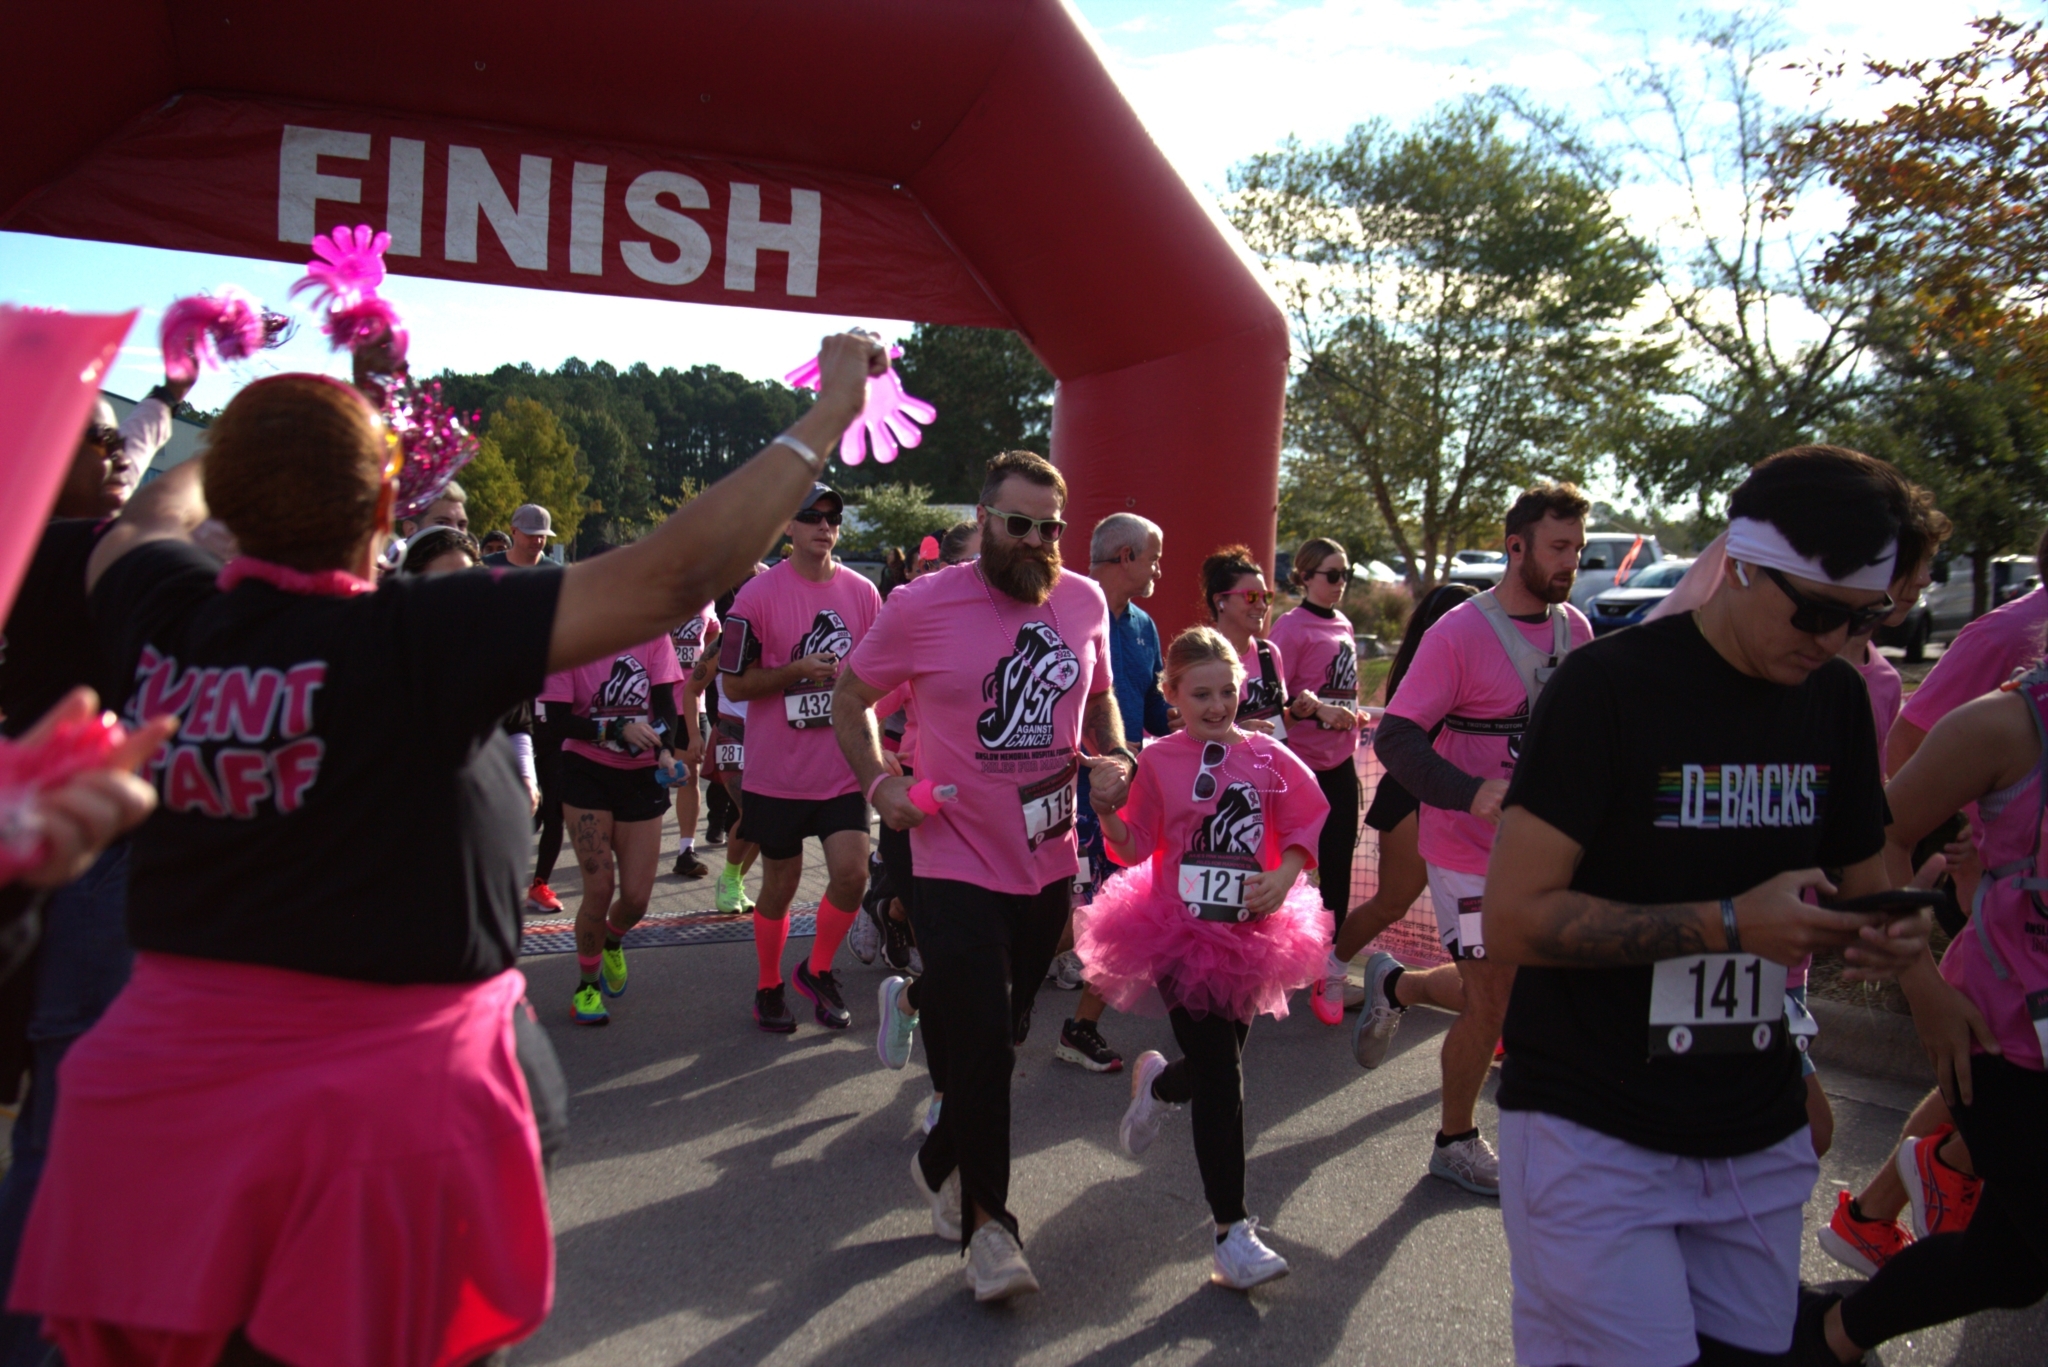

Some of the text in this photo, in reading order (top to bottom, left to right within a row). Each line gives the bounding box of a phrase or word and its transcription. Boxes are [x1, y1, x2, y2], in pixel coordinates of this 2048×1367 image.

[277, 123, 821, 298] FINISH
[676, 647, 695, 661] 283
[798, 693, 832, 717] 432
[1023, 684, 1061, 723] 5K
[1005, 734, 1053, 748] CANCER
[1016, 725, 1053, 734] AGAINST
[722, 745, 742, 761] 281
[1000, 752, 1030, 761] MEMORIAL
[1041, 784, 1073, 828] 119
[1680, 763, 1817, 828] D-BACKS
[1200, 869, 1246, 905] 121
[1688, 958, 1761, 1019] 141
